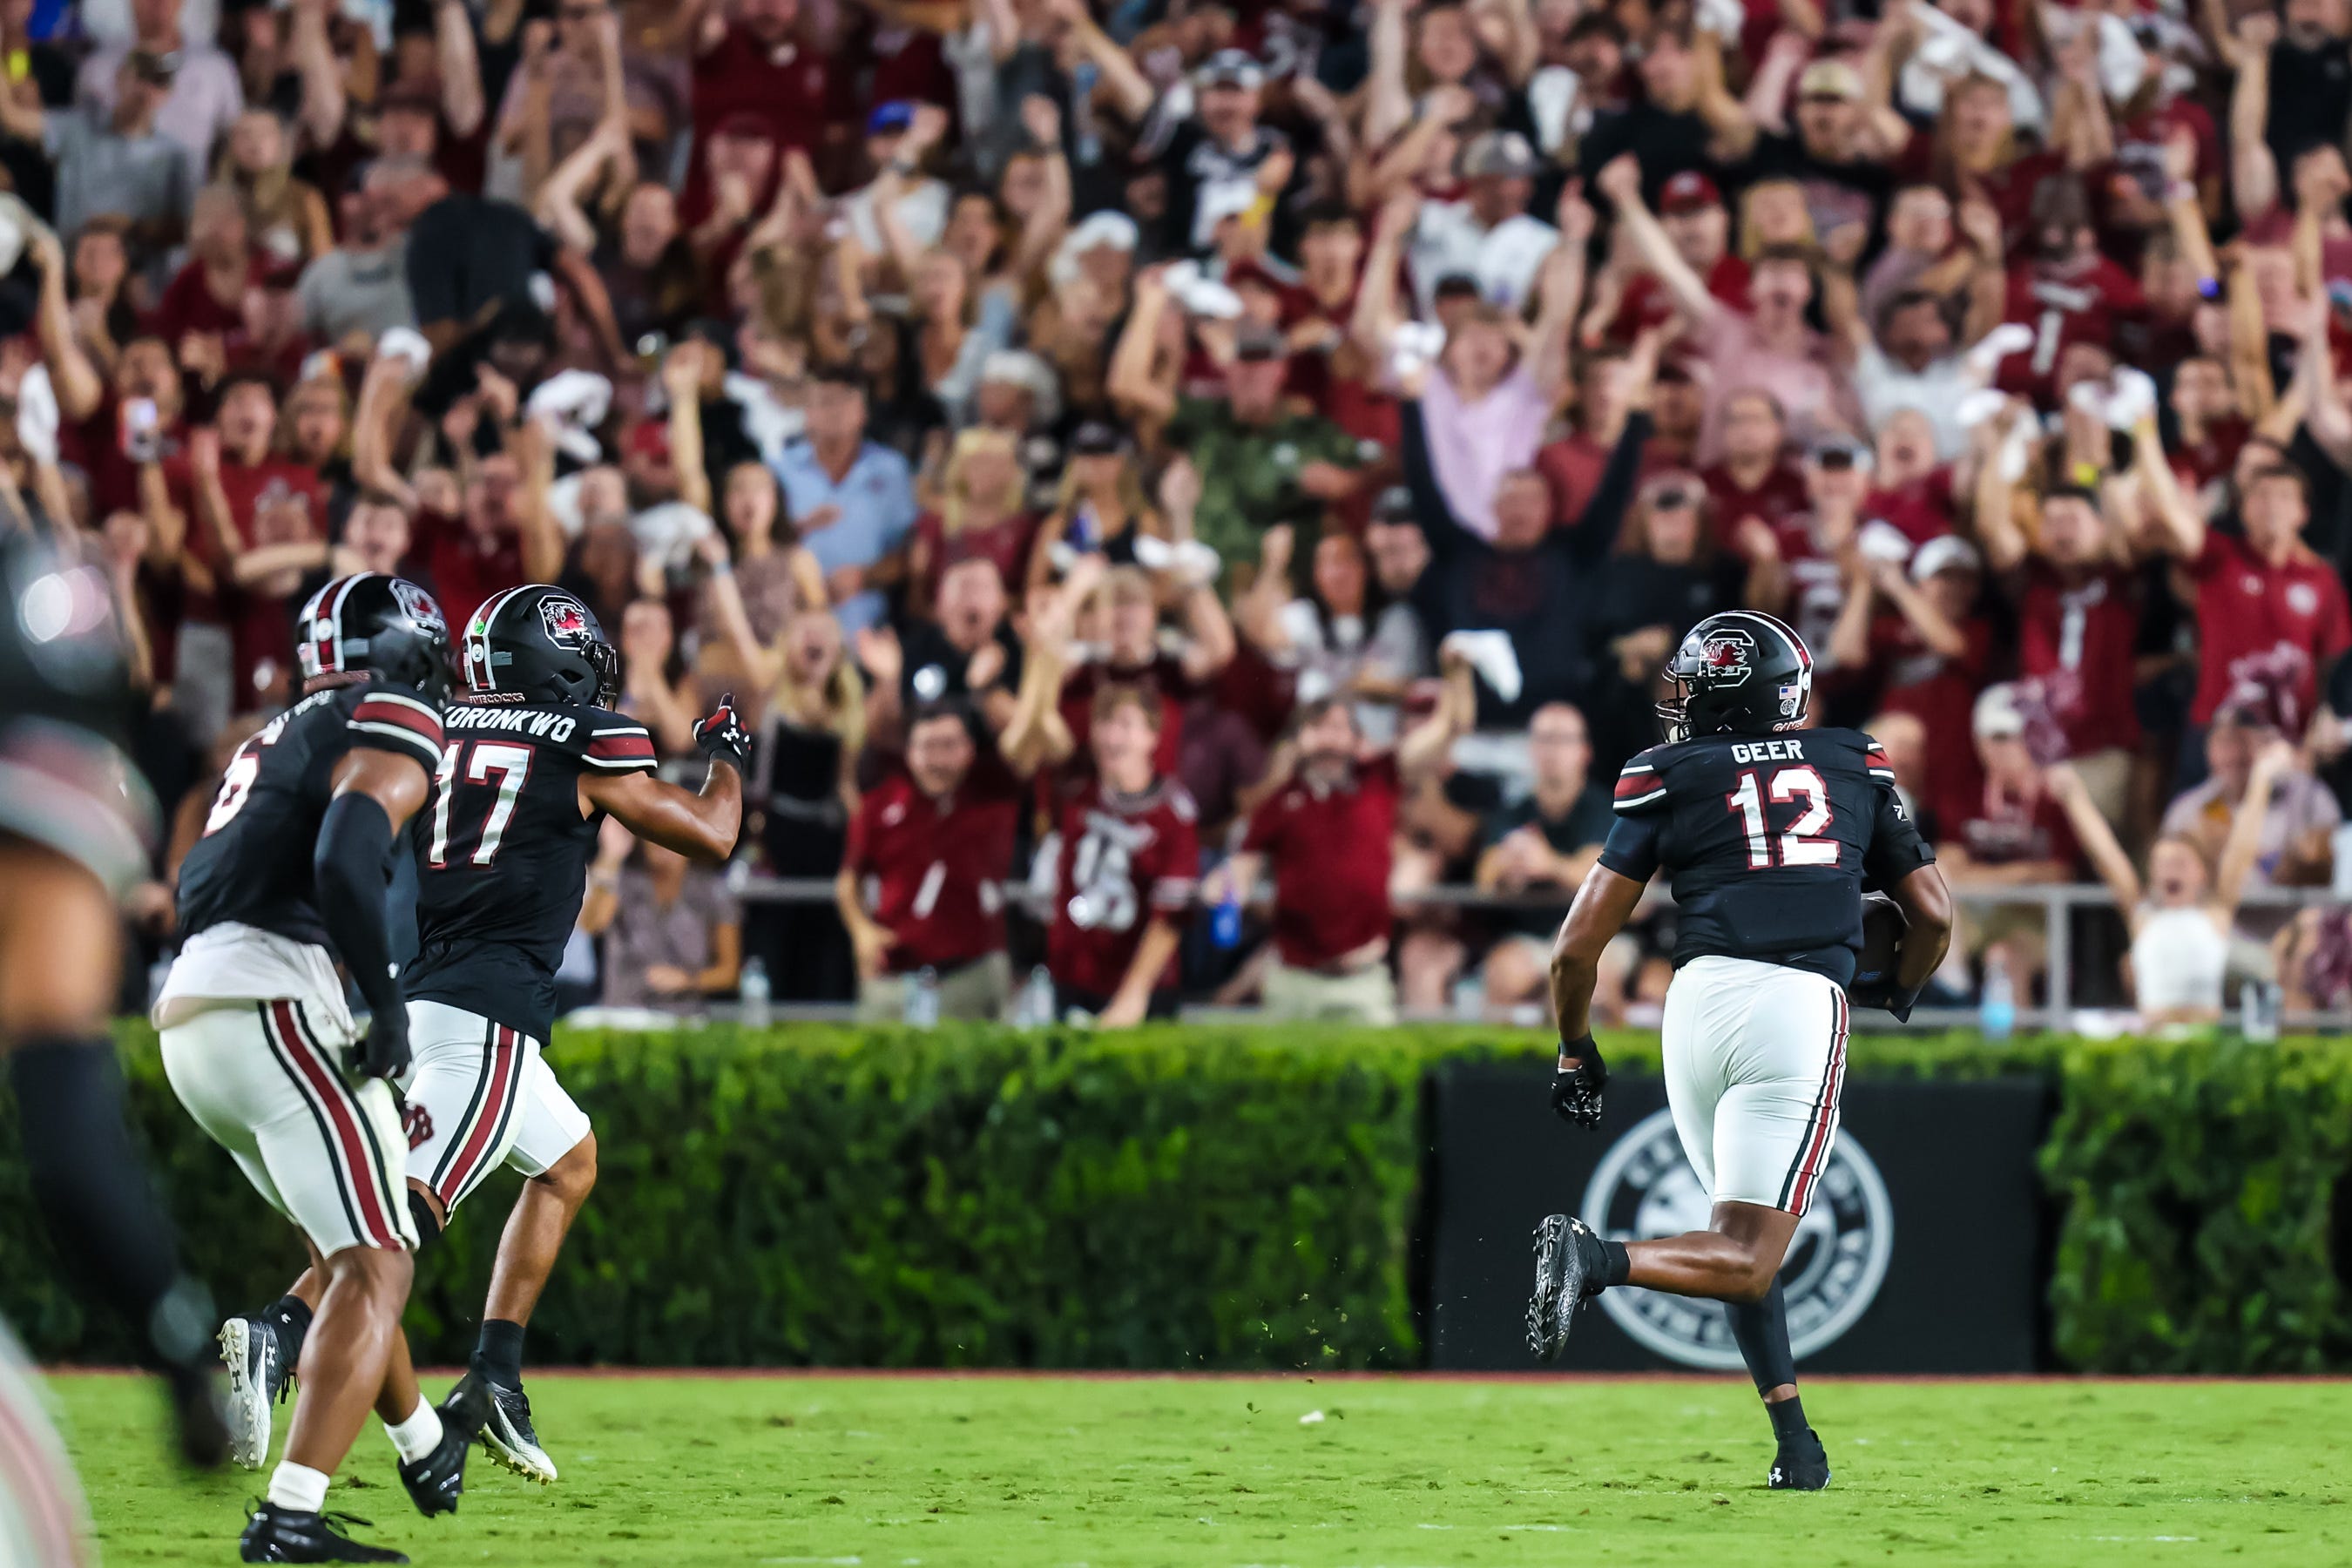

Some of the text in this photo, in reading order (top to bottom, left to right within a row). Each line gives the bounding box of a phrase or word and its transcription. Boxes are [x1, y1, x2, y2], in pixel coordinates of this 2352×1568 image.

[444, 706, 577, 743] ORONKWO
[1731, 740, 1805, 764] GEER
[428, 740, 536, 869] 17
[1726, 764, 1842, 869] 12
